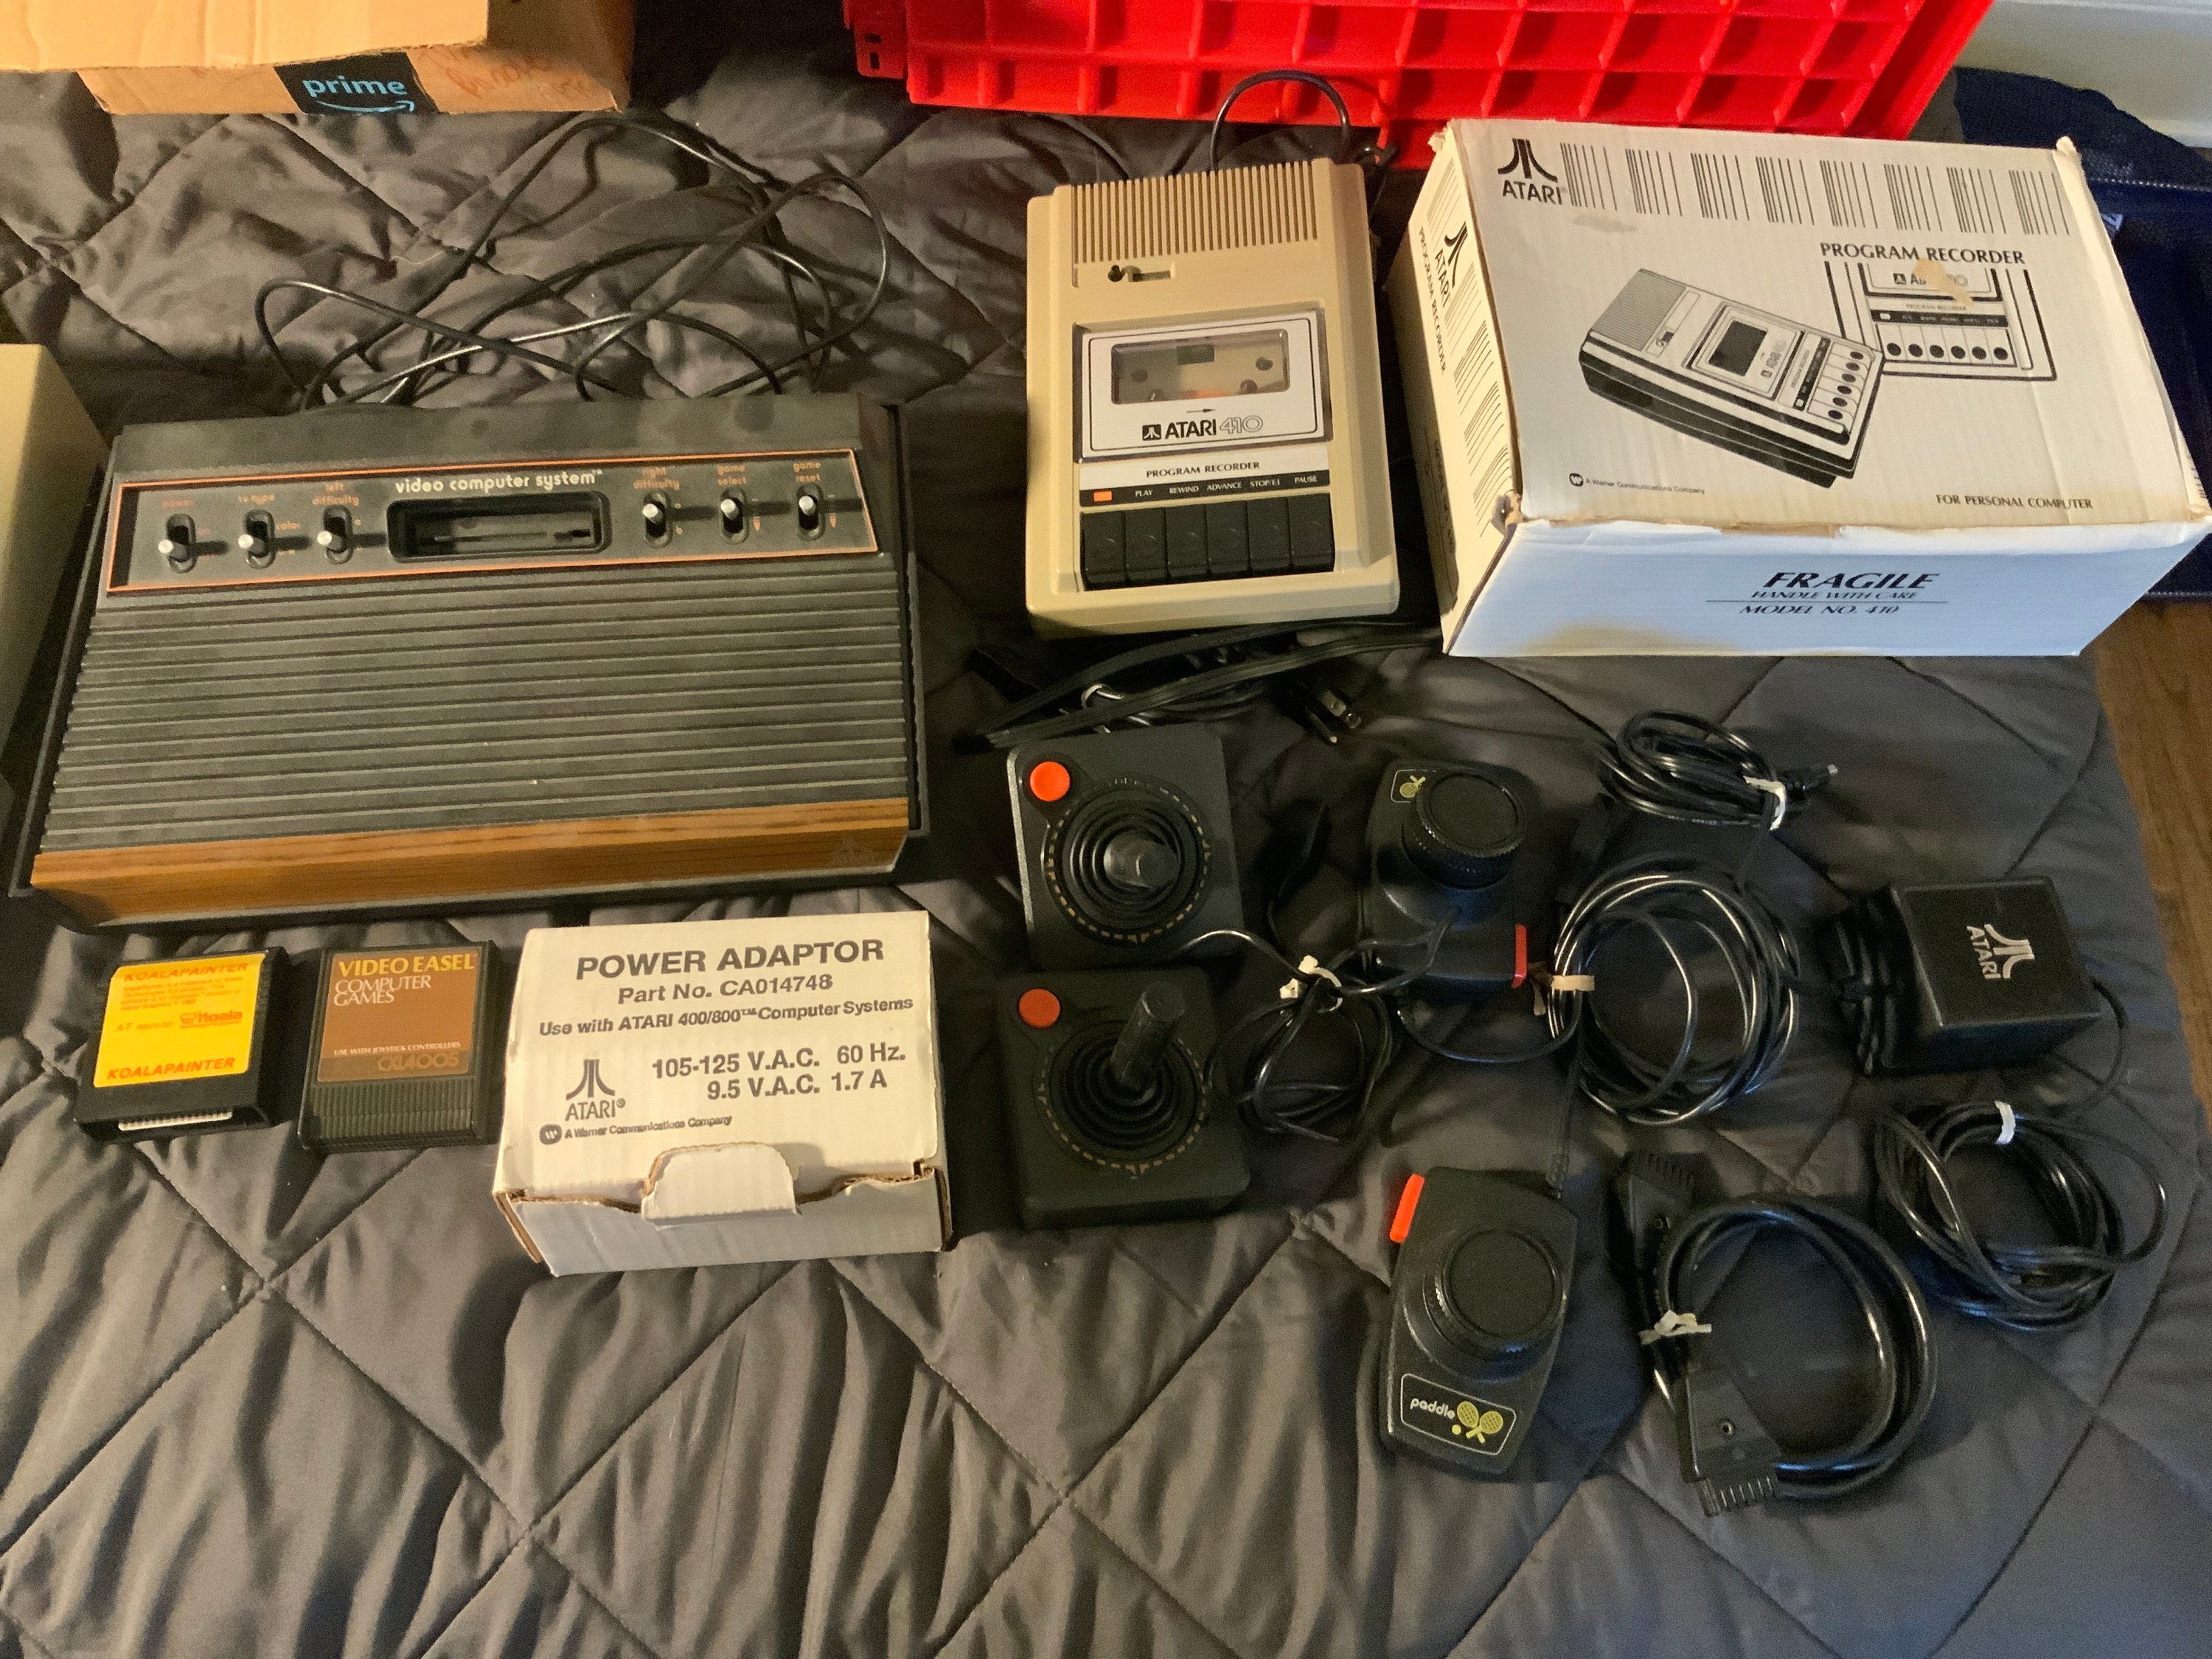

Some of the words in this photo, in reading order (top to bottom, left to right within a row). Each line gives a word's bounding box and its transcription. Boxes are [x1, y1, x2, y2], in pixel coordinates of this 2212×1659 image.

[302, 74, 406, 98] prime
[1502, 180, 1562, 205] ATARI
[1820, 243, 1919, 259] PROGRAM
[1926, 248, 2026, 265] RECORDER
[1435, 248, 1450, 308] ATARI
[1419, 226, 1435, 299] PROGRAM
[1430, 299, 1446, 372] RECORDER
[1165, 420, 1217, 439] ATARI
[1220, 415, 1263, 434] 410
[716, 465, 745, 476] game
[793, 462, 821, 472] game
[796, 473, 821, 483] reset
[1147, 466, 1200, 479] PROGRAM
[1205, 462, 1259, 473] RECORDER
[395, 478, 444, 493] video
[450, 476, 530, 493] computer
[1135, 490, 1153, 498] PLAY
[1169, 485, 1200, 495] REWIND
[1207, 481, 1242, 492] ADVANCE
[1294, 475, 1318, 484] PAUSE
[312, 494, 359, 506] difficulty
[1936, 494, 1961, 504] FOR
[1965, 495, 2023, 507] PERSONAL
[2028, 498, 2093, 509] COMPUTER
[1764, 572, 1940, 589] FRAGILE
[1876, 591, 1917, 599] CARE
[1739, 605, 1812, 614] MODEL
[1821, 605, 1857, 614] NO.
[1865, 605, 1899, 614] 410
[576, 950, 706, 980] POWER
[716, 939, 884, 971] ADAPTOR
[1966, 925, 2001, 979] ATARI
[124, 963, 248, 982] KOALAPAINTER
[338, 958, 408, 977] VIDEO
[413, 953, 474, 973] EASEL
[335, 975, 431, 995] COMPUTER
[618, 985, 666, 1004] Part
[672, 983, 712, 1000] No.
[720, 973, 833, 996] CA014748
[333, 990, 394, 1006] GAMES
[539, 1021, 572, 1036] Use
[577, 1018, 613, 1033] with
[618, 1013, 673, 1031] ATARI
[757, 1004, 841, 1020] Computer
[843, 998, 913, 1015] Systems
[372, 1045, 406, 1054] JOYSTICK
[408, 1041, 461, 1051] CONTROLLERS
[107, 1057, 236, 1079] KOALAPAINTER
[652, 1052, 740, 1079] 105-125
[747, 1047, 820, 1071] V.A.C.
[836, 1044, 863, 1065] 60
[869, 1041, 906, 1062] Hz.
[707, 1079, 740, 1100] 9.5
[747, 1073, 820, 1096] V.A.C.
[831, 1070, 863, 1091] 1.7
[869, 1068, 887, 1088] A
[565, 1129, 572, 1138] A
[574, 1127, 607, 1138] Warner
[610, 1119, 686, 1134] Communications
[688, 1116, 732, 1128] Company
[1410, 1398, 1455, 1419] paddle
